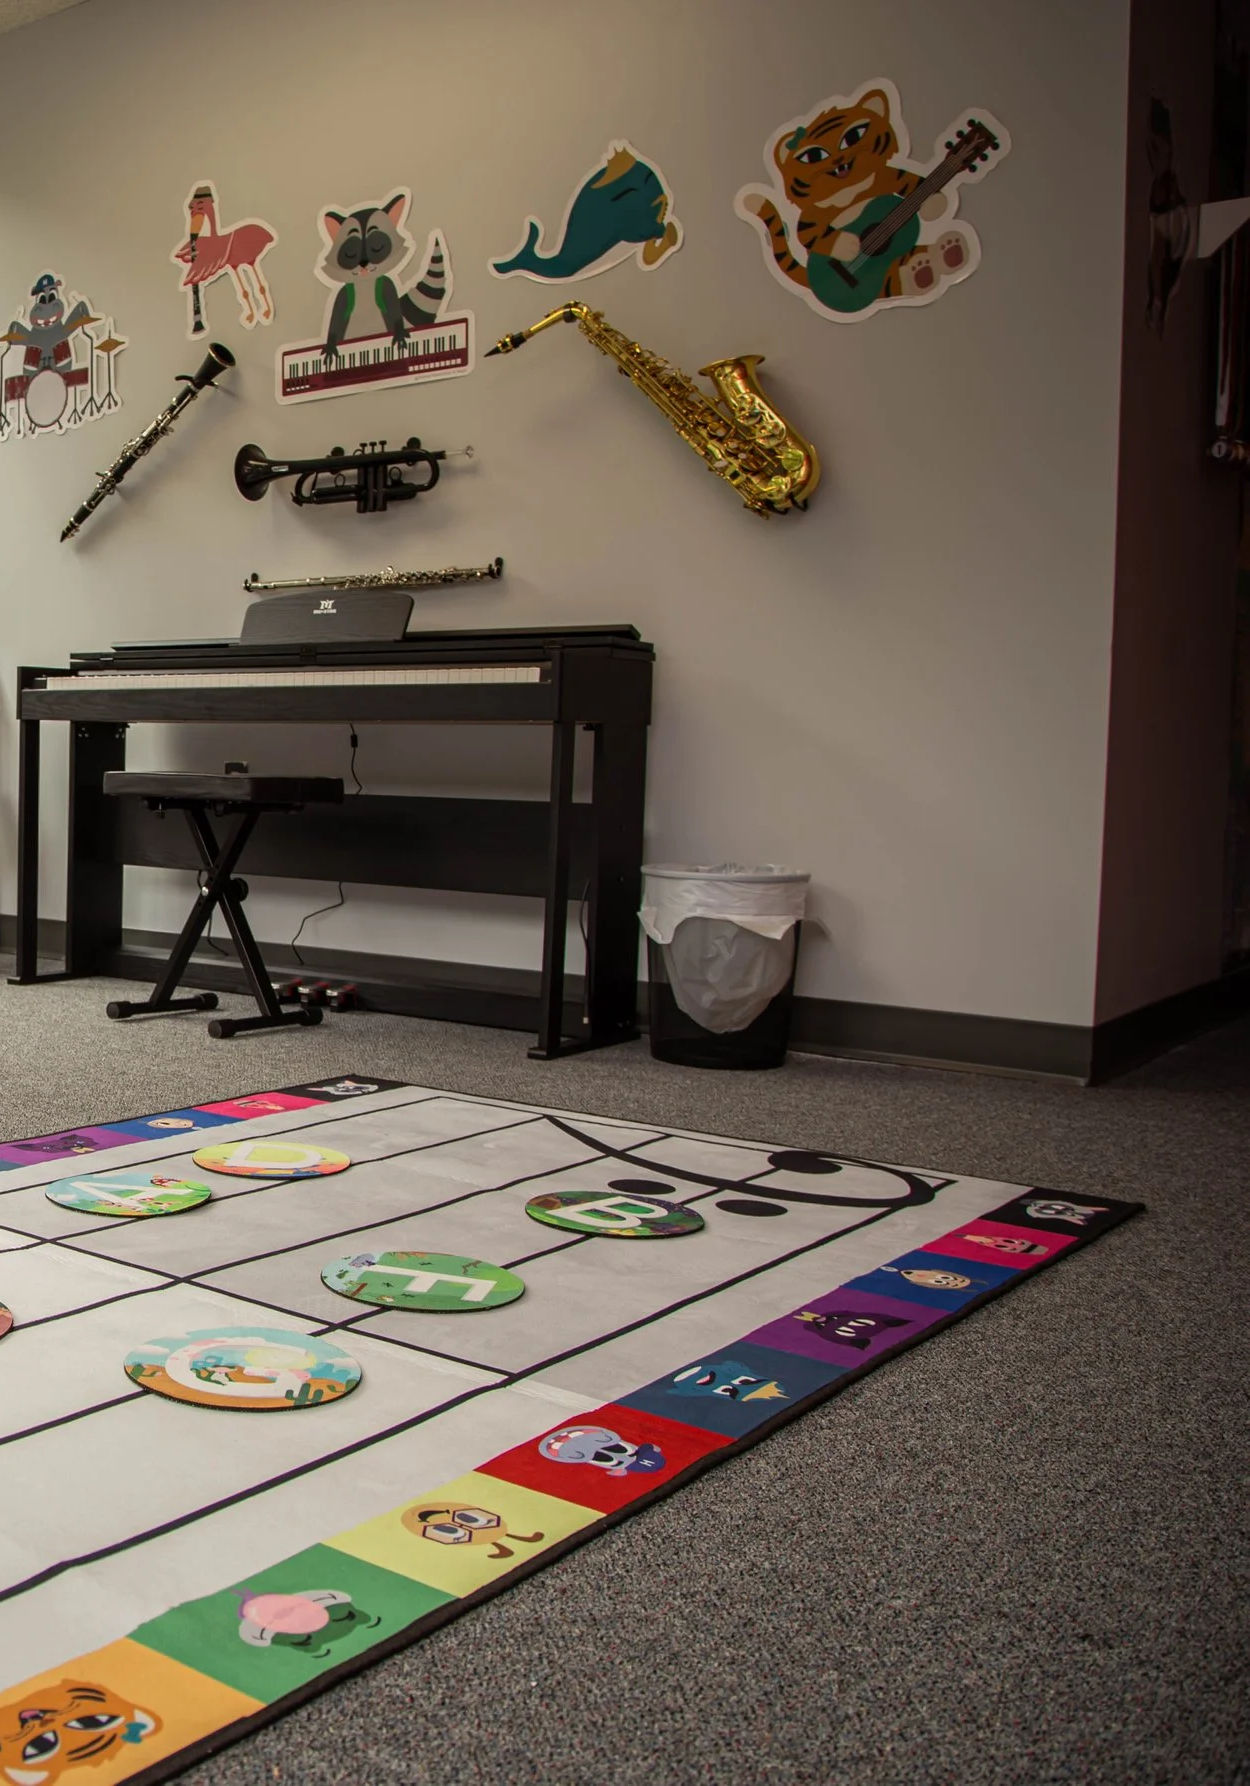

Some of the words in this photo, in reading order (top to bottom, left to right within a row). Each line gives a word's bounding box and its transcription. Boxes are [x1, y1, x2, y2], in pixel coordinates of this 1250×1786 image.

[224, 1141, 322, 1168] D
[69, 1181, 195, 1212] A
[545, 1196, 668, 1229] B
[352, 1264, 498, 1302] F
[165, 1337, 312, 1399] G
